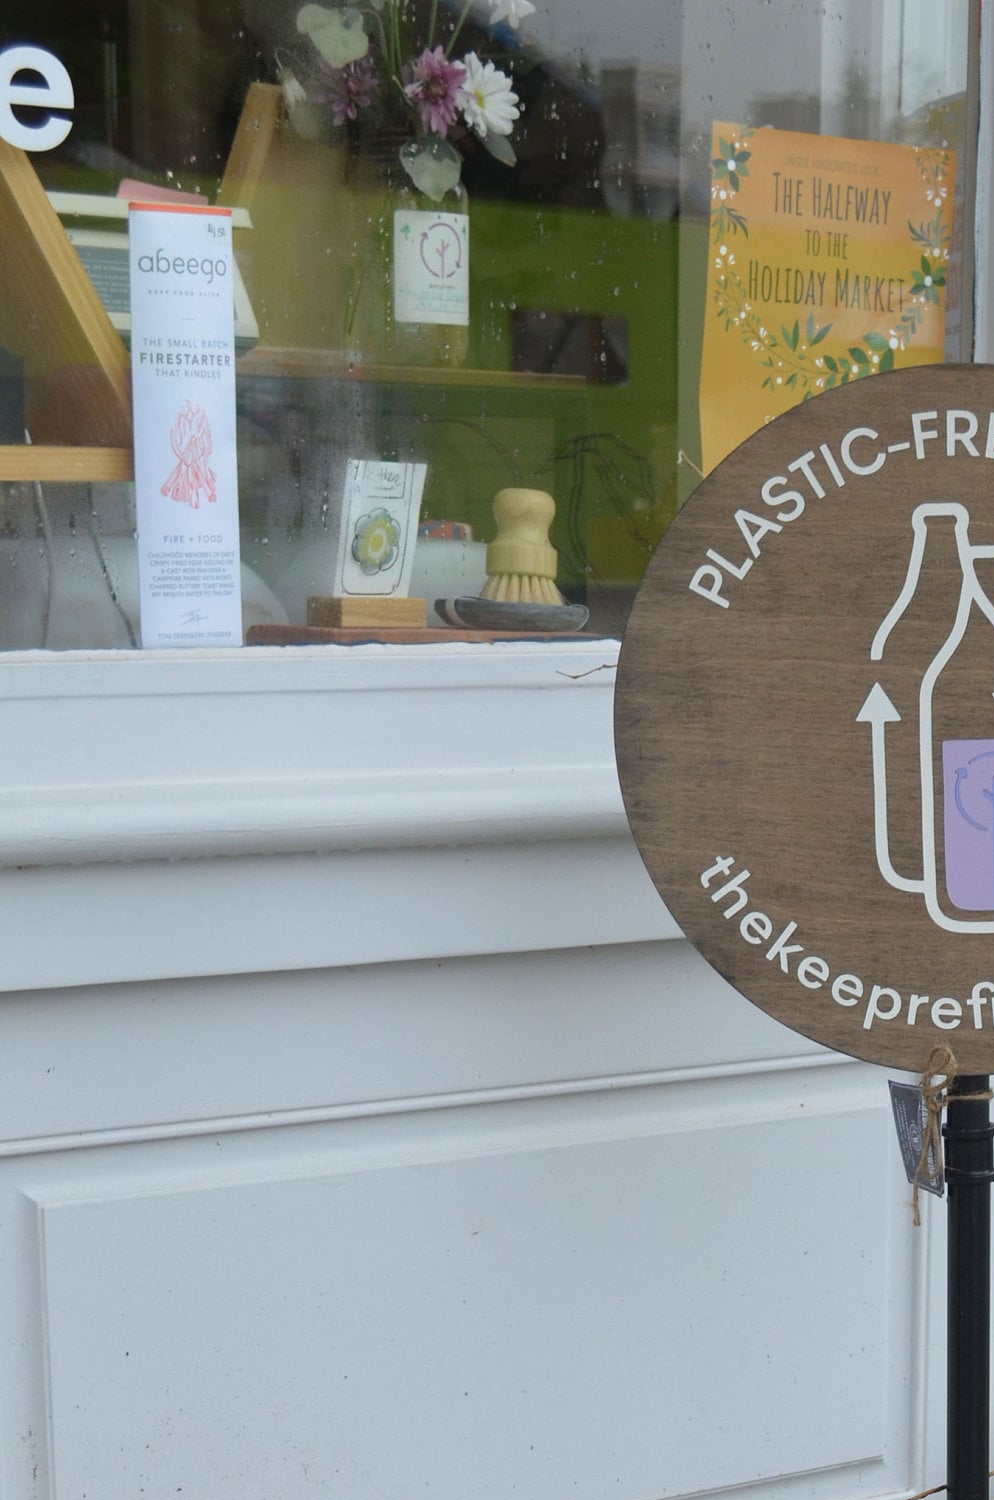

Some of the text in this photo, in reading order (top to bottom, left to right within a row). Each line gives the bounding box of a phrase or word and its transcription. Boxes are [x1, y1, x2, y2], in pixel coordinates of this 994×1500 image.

[0, 46, 74, 152] e
[772, 172, 892, 226] THE HALFWAY
[805, 229, 849, 260] TO THE
[138, 248, 227, 284] abeego
[748, 260, 906, 314] HOLIDAY MARKET
[140, 352, 231, 367] FIRESTARTER
[143, 338, 228, 350] THE SMALL BATCH
[156, 369, 222, 379] THAT KINDLES
[163, 535, 185, 543] FIRE
[198, 535, 223, 543] FOOD
